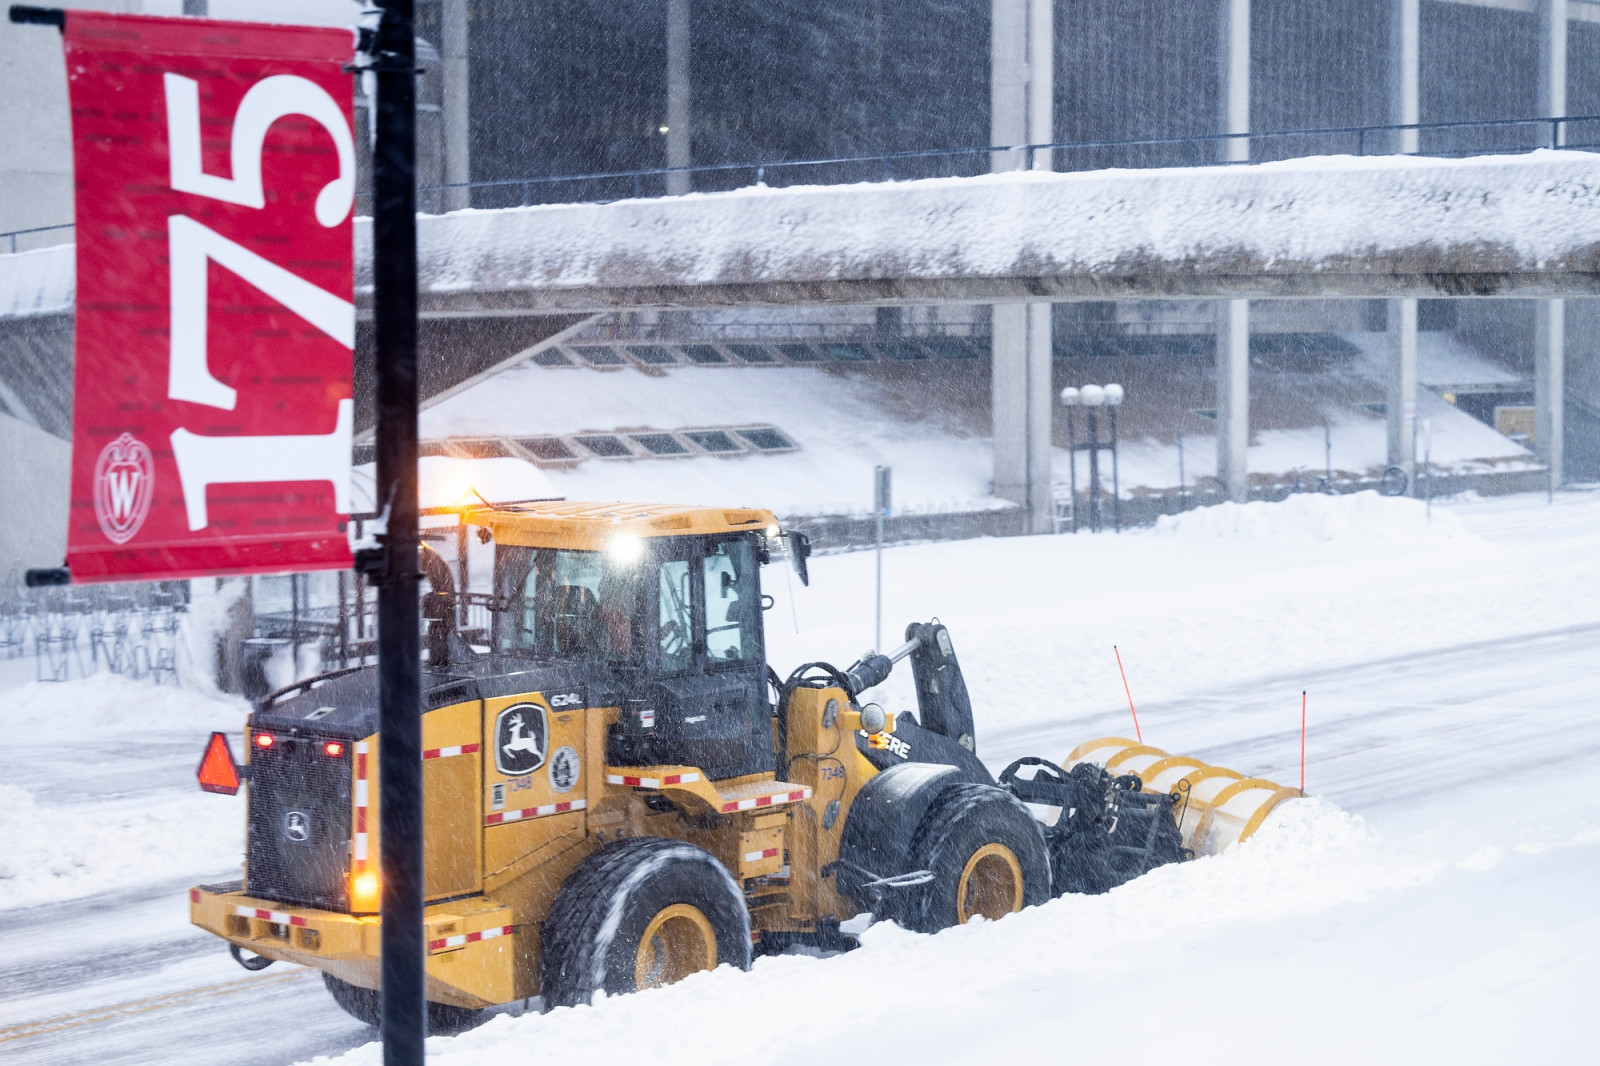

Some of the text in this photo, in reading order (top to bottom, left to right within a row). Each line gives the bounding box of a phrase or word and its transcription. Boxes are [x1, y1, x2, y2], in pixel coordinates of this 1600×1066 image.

[164, 72, 356, 532] 175
[109, 468, 141, 519] W
[859, 728, 912, 760] ERE
